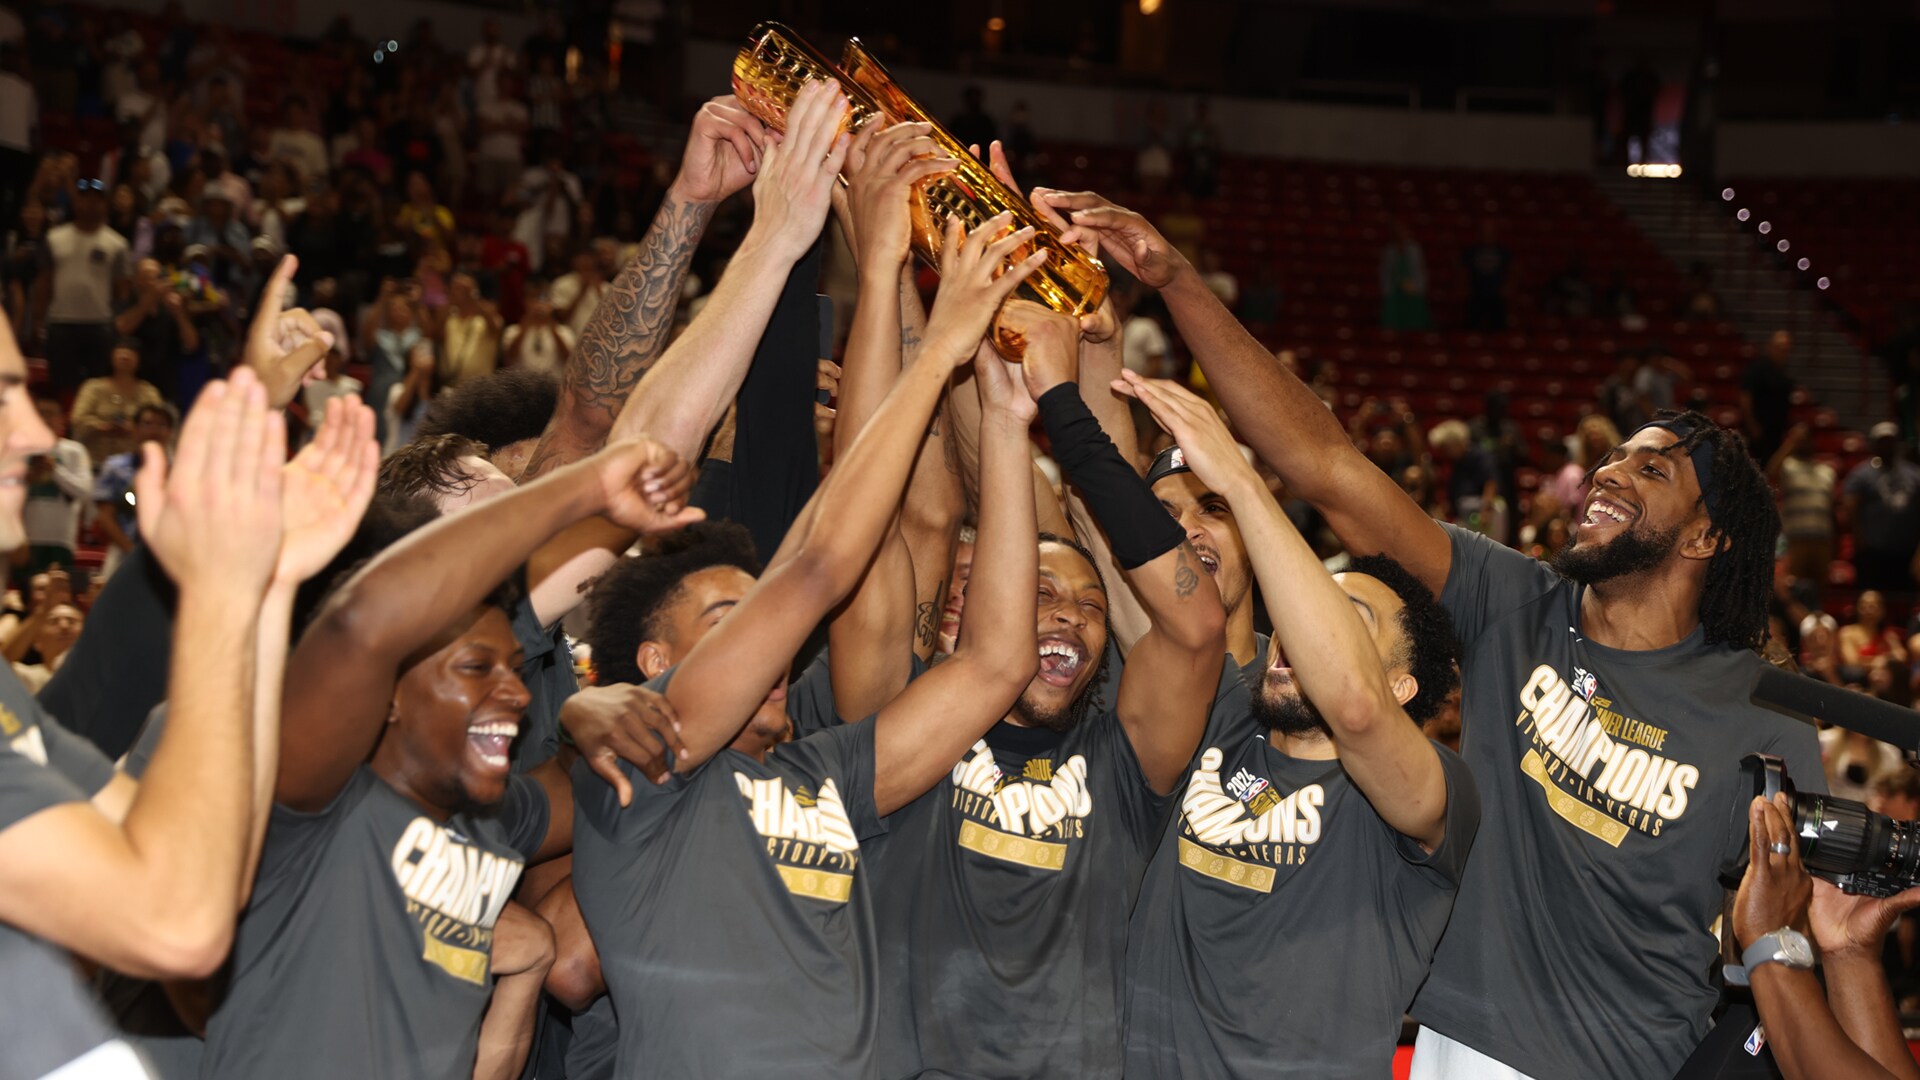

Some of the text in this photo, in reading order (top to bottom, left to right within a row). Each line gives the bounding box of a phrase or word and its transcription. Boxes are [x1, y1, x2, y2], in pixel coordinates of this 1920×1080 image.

[1519, 664, 1700, 820] CHAMPIONS
[1621, 717, 1668, 751] LEAGUE
[1226, 767, 1256, 798] 2024
[952, 788, 1000, 824] VICTOR
[1606, 798, 1663, 837] VEGAS
[1249, 844, 1306, 865] VEGAS
